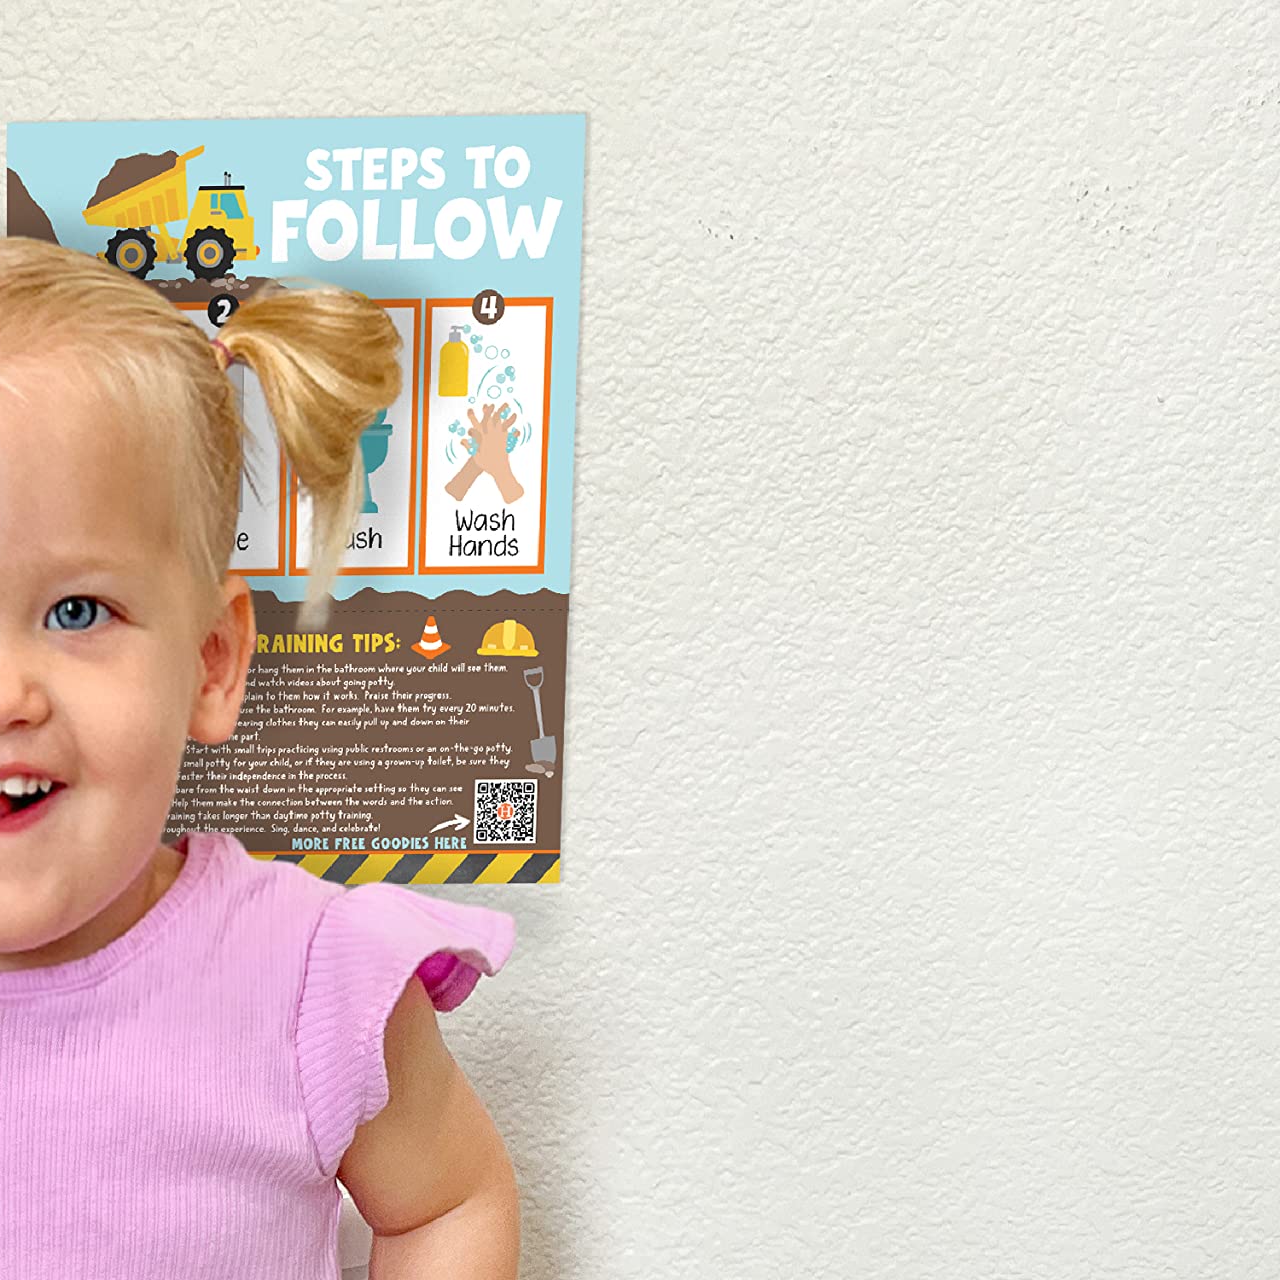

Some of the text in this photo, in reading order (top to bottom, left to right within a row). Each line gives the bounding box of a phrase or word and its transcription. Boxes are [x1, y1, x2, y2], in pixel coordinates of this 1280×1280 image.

[305, 145, 530, 190] STEPS TO
[272, 196, 562, 262] FOLLOW
[216, 299, 231, 323] 2
[480, 296, 498, 320] 4
[456, 509, 514, 531] Wash
[449, 535, 518, 556] Hands
[258, 633, 400, 653] RAINING TIPS:
[258, 664, 278, 676] hang
[282, 664, 304, 673] them
[316, 664, 333, 673] the
[334, 664, 375, 674] bathroom
[378, 664, 404, 674] where
[406, 666, 425, 675] your
[428, 663, 448, 672] child
[451, 663, 465, 672] will
[245, 678, 256, 687] nd
[258, 677, 285, 686] watch
[288, 678, 314, 686] videos
[316, 677, 341, 686] about
[343, 680, 366, 690] going
[244, 691, 263, 703] plain
[279, 691, 300, 700] them
[303, 691, 320, 700] how
[363, 690, 388, 700] Praise
[392, 690, 413, 699] their
[256, 704, 270, 713] the
[322, 704, 336, 713] For
[375, 704, 394, 713] have
[397, 703, 419, 712] them
[423, 703, 436, 715] try
[440, 706, 463, 715] every
[235, 720, 264, 731] earing
[266, 718, 295, 726] clothes
[298, 718, 318, 730] they
[338, 718, 361, 730] easily
[364, 717, 377, 730] pull
[392, 717, 407, 726] and
[410, 717, 433, 725] down
[448, 716, 469, 725] their
[185, 744, 208, 753] Start
[211, 744, 231, 753] with
[235, 744, 254, 753] small
[257, 744, 276, 756] trips
[278, 744, 319, 756] practicing
[322, 745, 344, 756] using
[345, 744, 368, 756] public
[372, 743, 413, 753] restrooms
[440, 743, 483, 755] on-the-go
[184, 758, 203, 767] small
[206, 758, 230, 770] potty
[233, 758, 247, 767] for
[248, 761, 267, 770] your
[315, 757, 336, 770] they
[354, 760, 375, 770] using
[385, 760, 424, 769] grown-up
[489, 756, 510, 769] they
[207, 771, 227, 780] their
[229, 771, 286, 783] independence
[298, 770, 314, 779] the
[175, 784, 194, 794] bare
[196, 784, 217, 793] from
[219, 784, 234, 793] the
[237, 784, 259, 793] waist
[263, 784, 285, 793] down
[298, 784, 313, 793] the
[315, 784, 362, 795] appropriate
[365, 783, 395, 795] setting
[409, 783, 429, 795] they
[172, 798, 189, 810] Help
[191, 798, 214, 806] them
[216, 798, 237, 806] make
[240, 798, 255, 806] the
[257, 798, 303, 806] connection
[305, 797, 342, 806] between
[345, 797, 359, 805] the
[362, 797, 387, 805] words
[390, 797, 405, 805] and
[408, 797, 423, 805] the
[166, 811, 196, 823] raining
[198, 811, 220, 820] takes
[223, 811, 248, 823] longer
[251, 810, 270, 819] than
[274, 810, 308, 822] daytime
[311, 810, 335, 822] potty
[203, 823, 219, 833] the
[322, 823, 337, 832] and
[339, 823, 380, 832] celebrate!
[292, 836, 467, 850] MORE FREE GOODIES HERE
